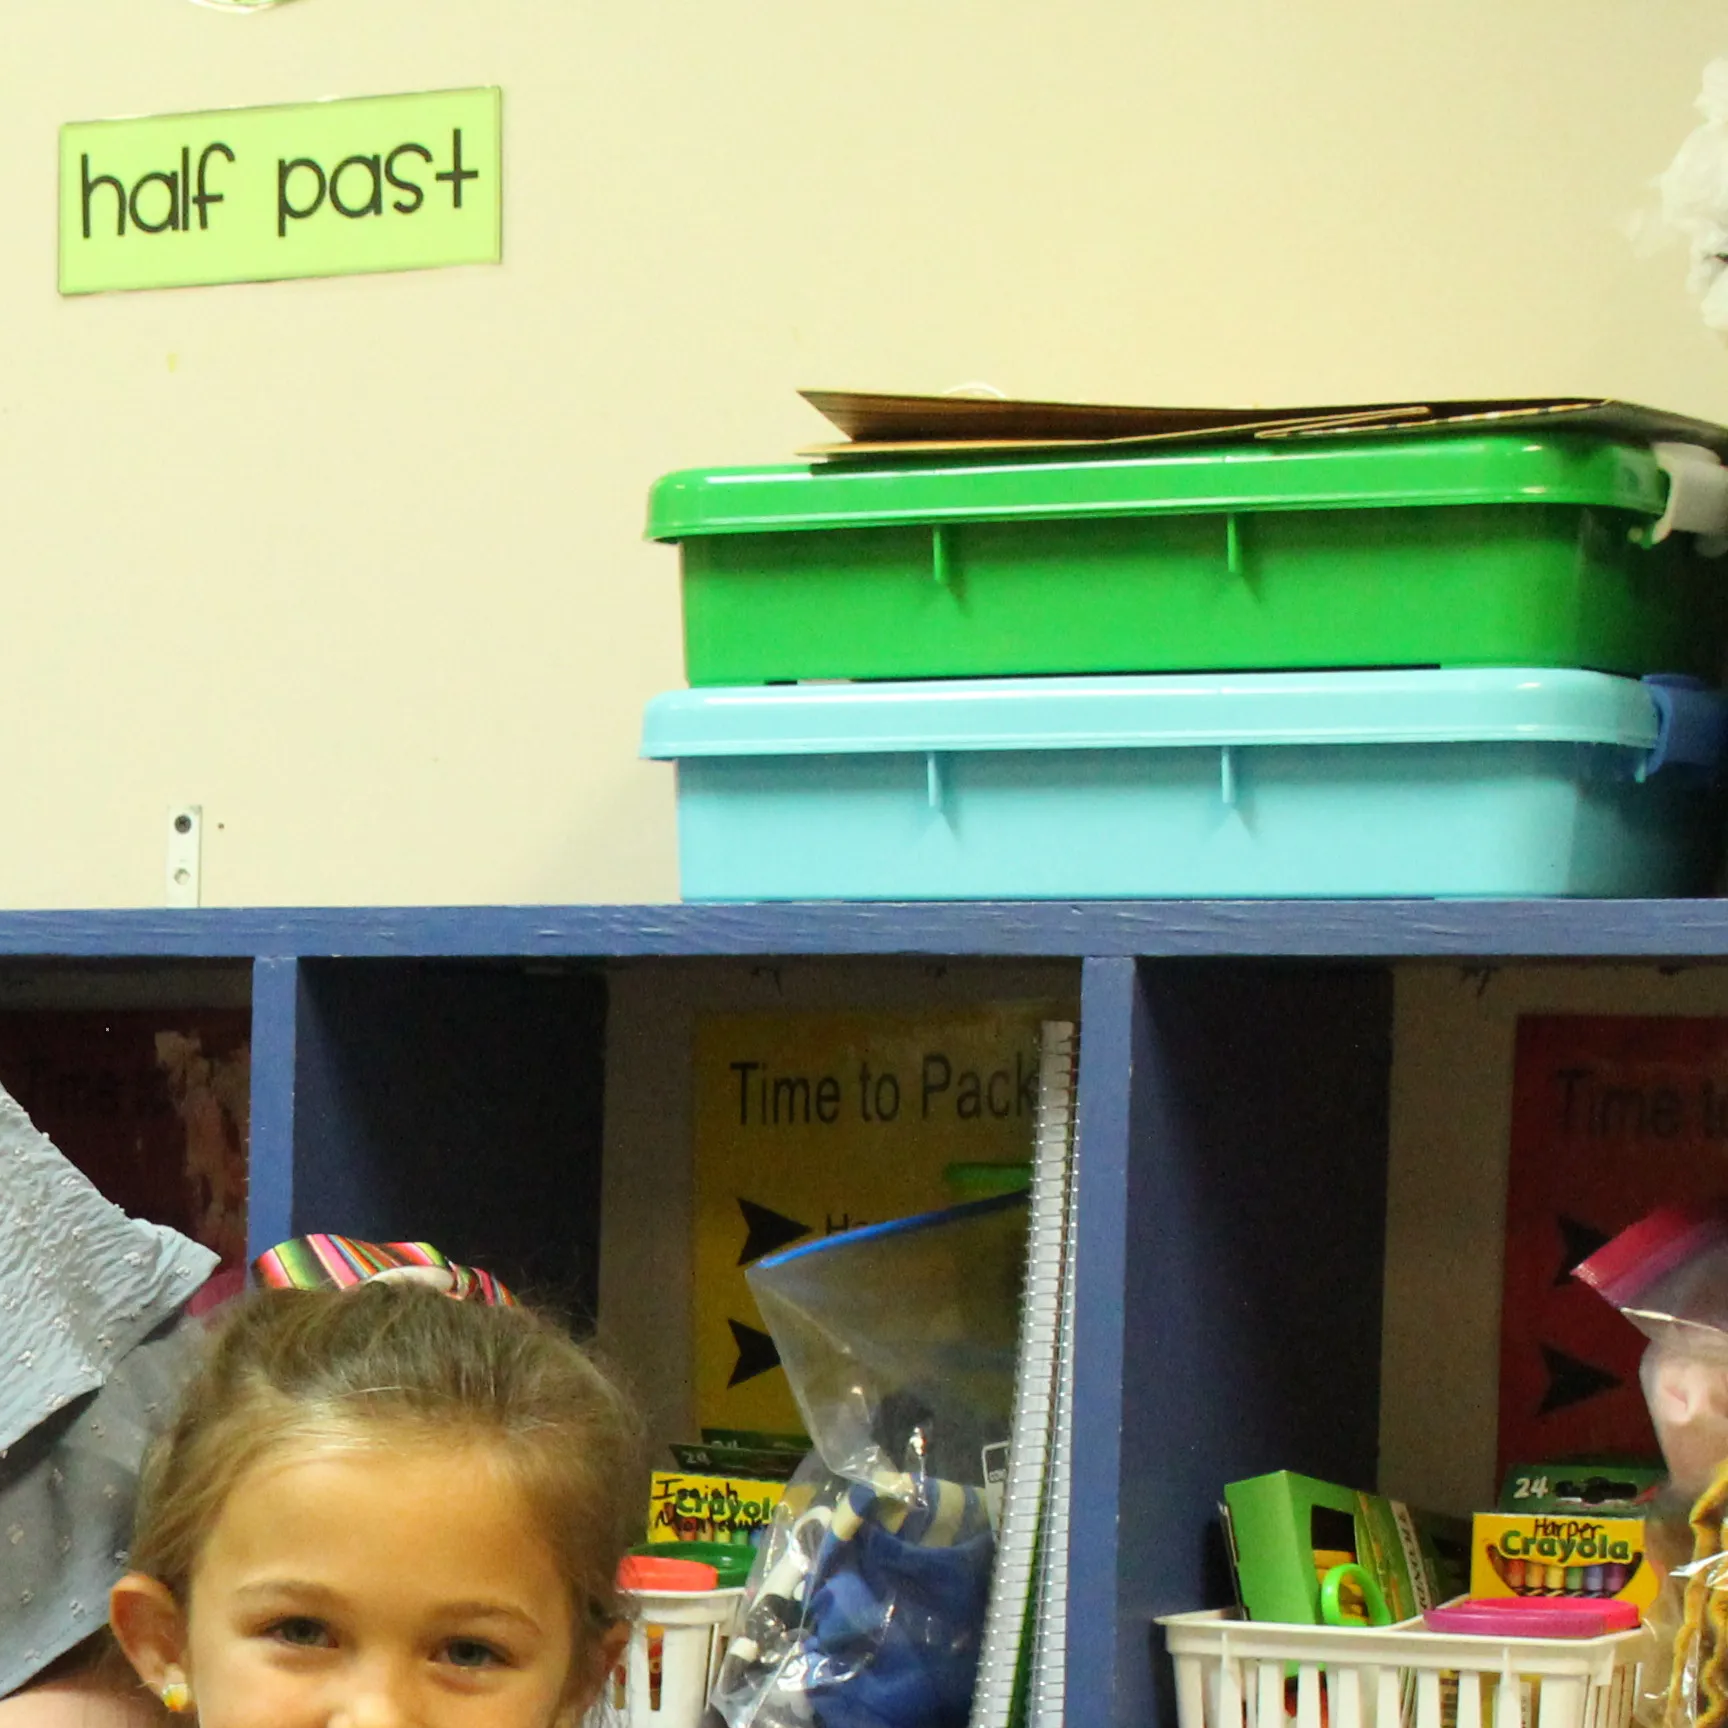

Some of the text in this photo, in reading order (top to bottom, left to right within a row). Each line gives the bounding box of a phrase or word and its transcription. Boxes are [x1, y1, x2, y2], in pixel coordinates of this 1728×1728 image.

[81, 128, 480, 239] half past
[730, 1061, 841, 1125] Time
[859, 1062, 900, 1122] to
[1513, 1476, 1548, 1499] 24
[1500, 1530, 1630, 1563] Crayola
[1533, 1517, 1604, 1543] Harper
